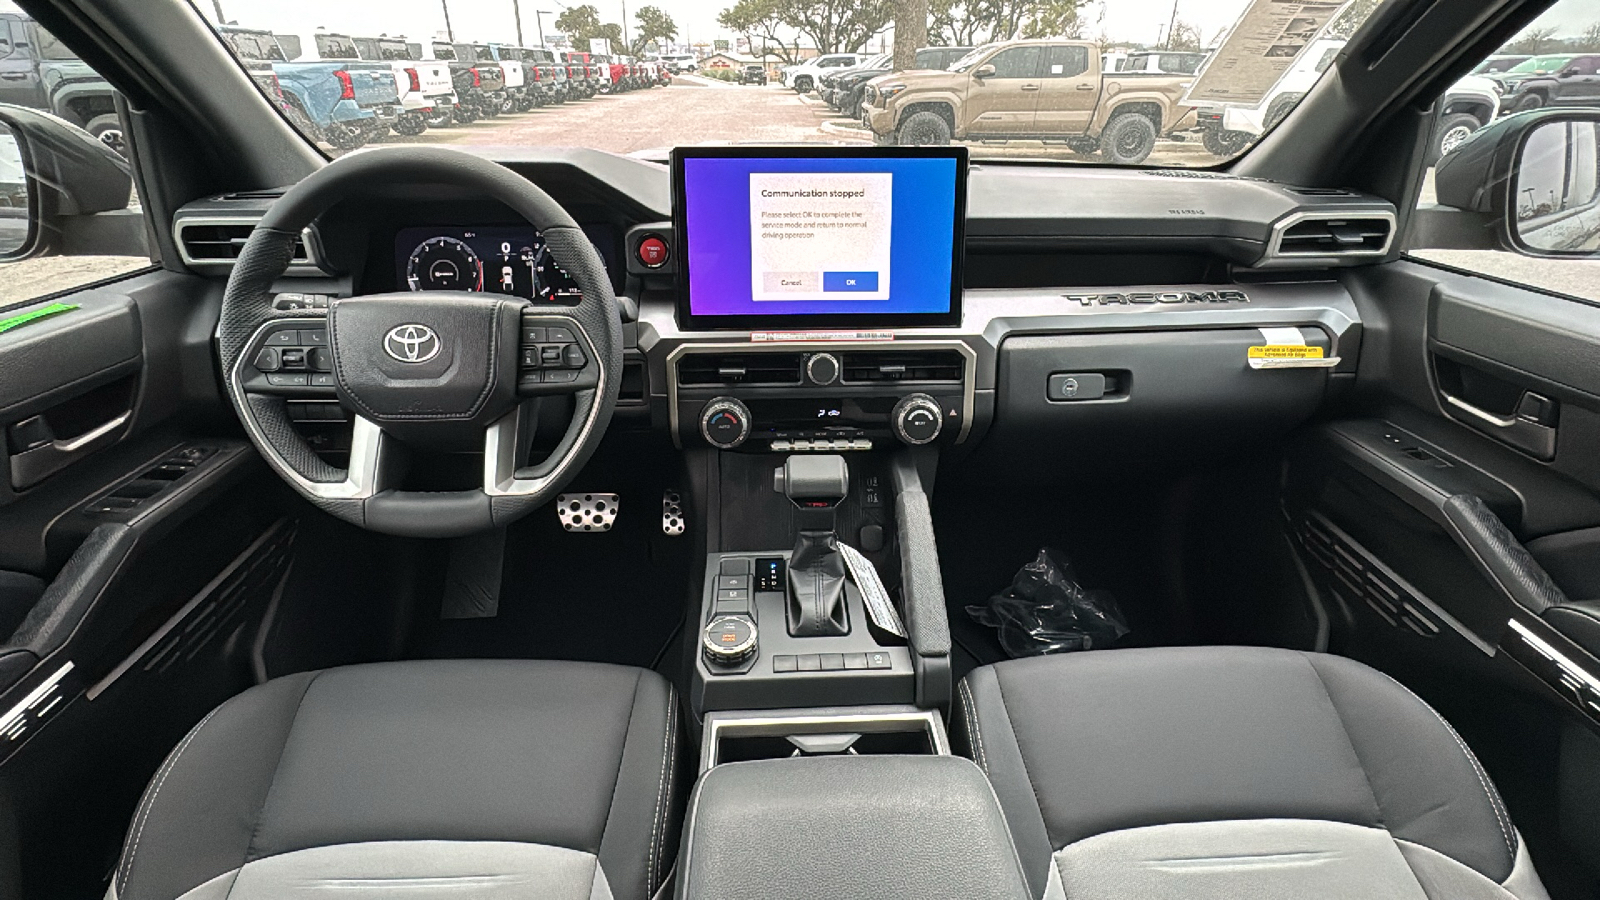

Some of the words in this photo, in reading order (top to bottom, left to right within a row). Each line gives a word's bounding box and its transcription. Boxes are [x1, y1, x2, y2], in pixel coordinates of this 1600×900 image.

[761, 189, 828, 198] Communication
[829, 188, 865, 199] stopped
[821, 211, 851, 219] complete
[761, 232, 784, 240] driving
[501, 242, 511, 253] 0
[1061, 290, 1250, 306] TACOMA
